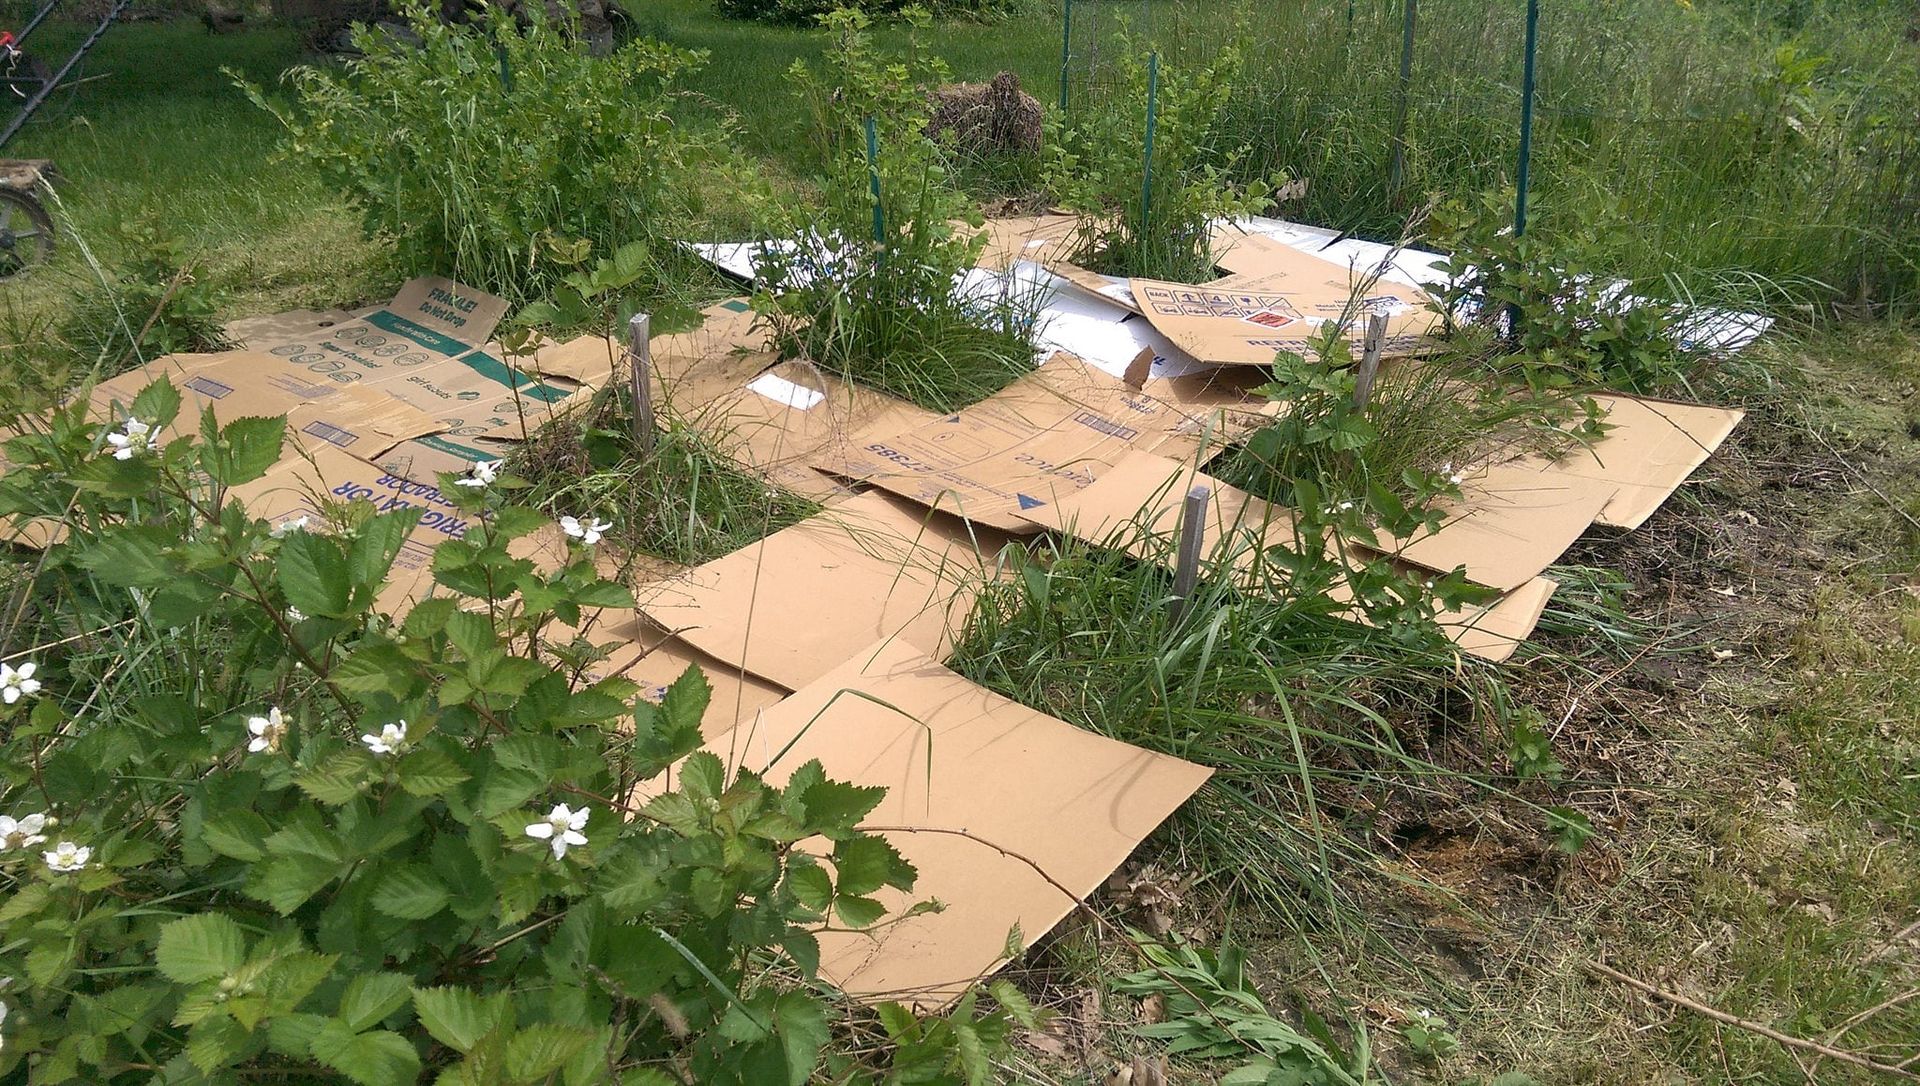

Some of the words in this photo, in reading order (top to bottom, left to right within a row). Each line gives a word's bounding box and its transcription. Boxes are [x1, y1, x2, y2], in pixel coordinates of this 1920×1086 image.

[419, 301, 432, 313] Do
[430, 304, 448, 319] Not
[444, 311, 467, 328] Drop
[406, 376, 431, 390] girl
[425, 384, 452, 400] scouts
[864, 444, 934, 473] 27385
